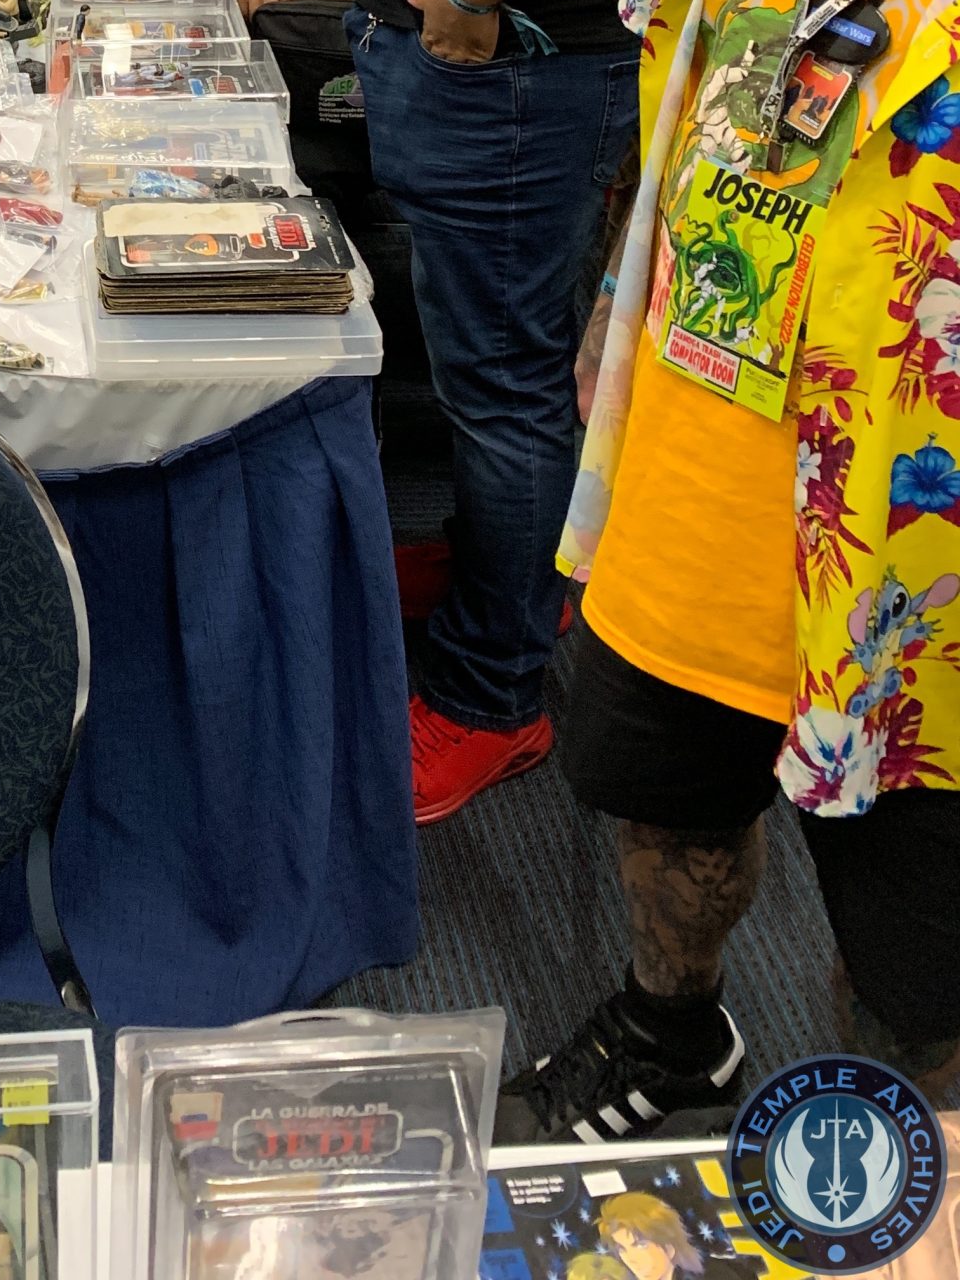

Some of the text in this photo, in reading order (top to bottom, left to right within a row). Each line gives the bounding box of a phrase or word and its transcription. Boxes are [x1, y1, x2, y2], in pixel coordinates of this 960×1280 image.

[831, 20, 848, 33] Star
[849, 27, 872, 44] Wars
[703, 168, 813, 235] JOSEPH
[778, 232, 817, 345] CELEBRATION 2022
[669, 339, 711, 374] COMPACTOR
[711, 360, 735, 387] ROOM
[250, 1102, 390, 1120] LA GUERRA DE
[257, 1123, 375, 1159] JEDI
